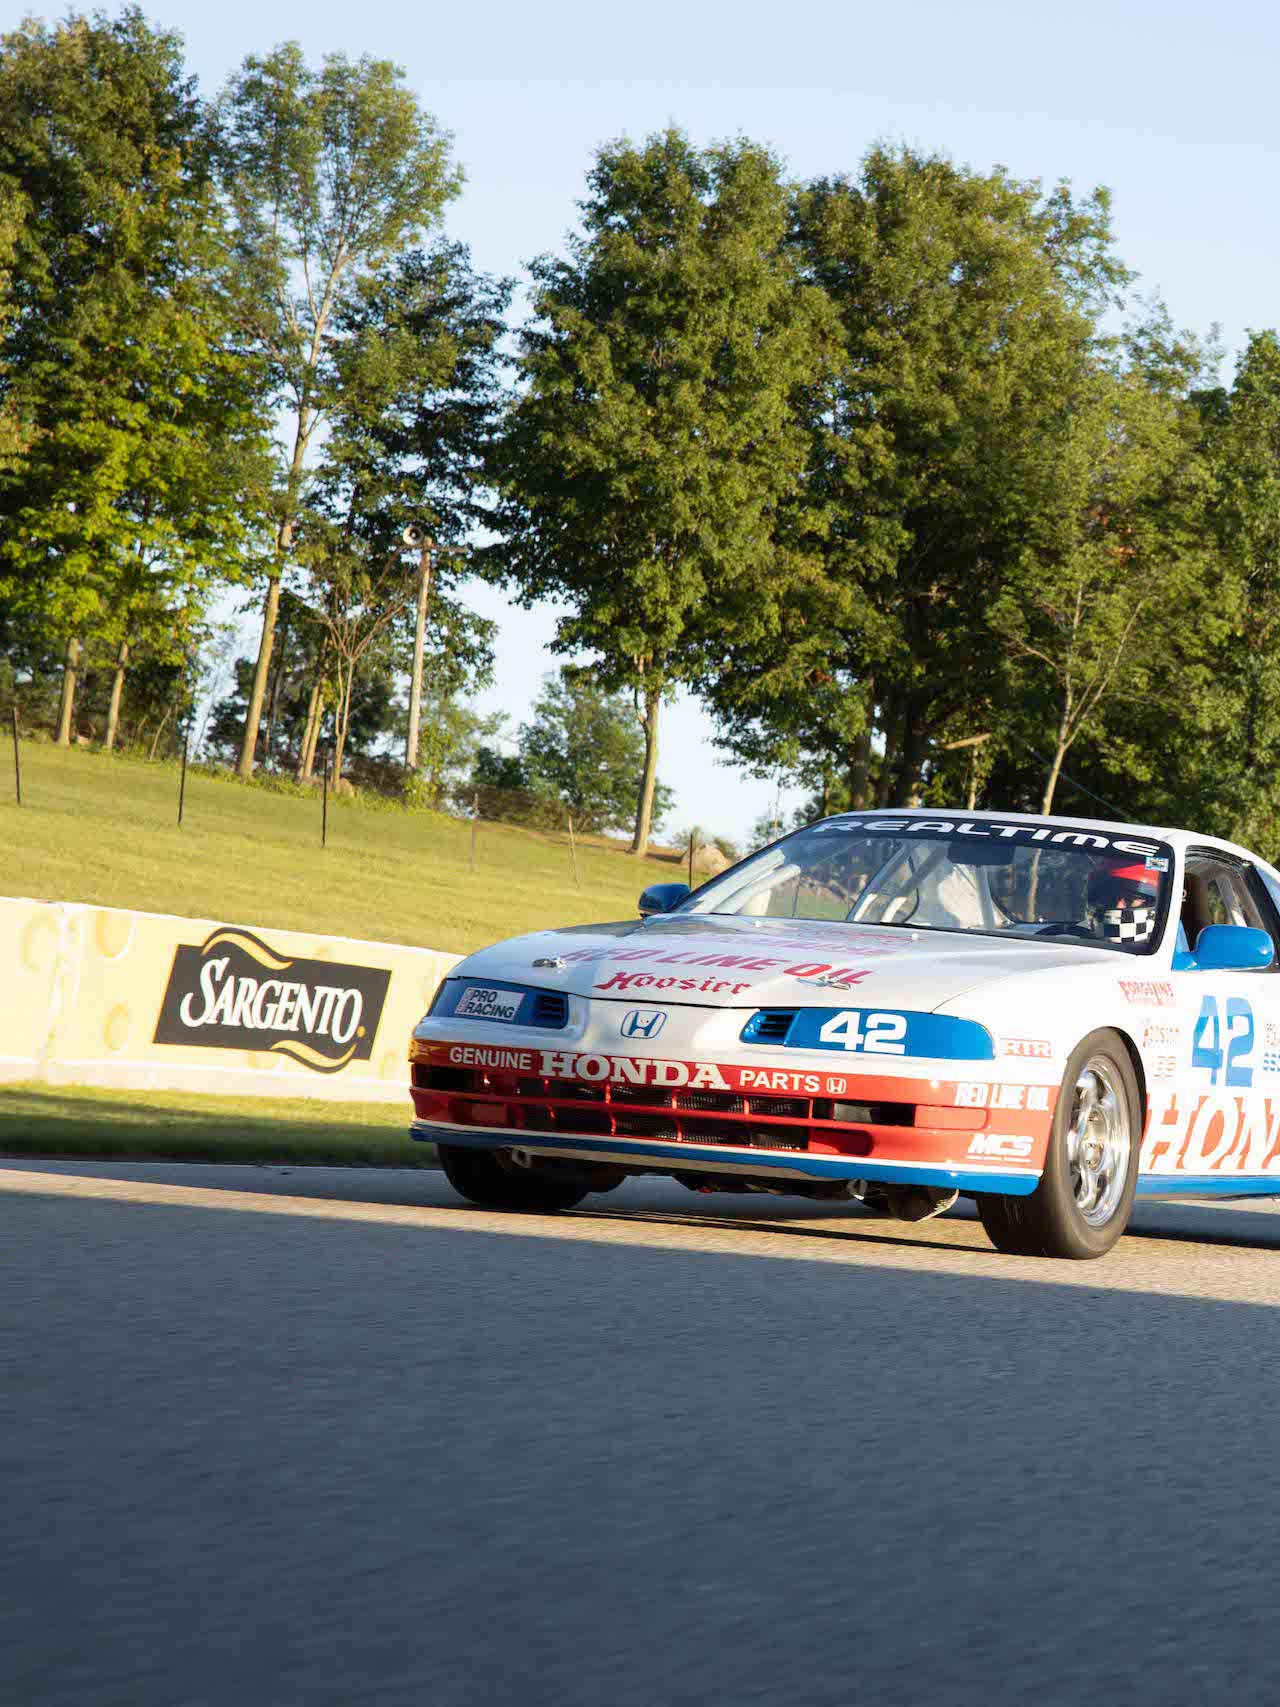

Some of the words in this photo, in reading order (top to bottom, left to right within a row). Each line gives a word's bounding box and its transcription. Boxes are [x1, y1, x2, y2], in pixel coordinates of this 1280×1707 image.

[813, 820, 1160, 857] REALTIME
[652, 951, 792, 970] LINE
[783, 963, 875, 985] OIL
[470, 989, 498, 1003] PRO
[592, 971, 752, 995] Hoosier
[180, 957, 362, 1043] SARGENTO
[464, 1002, 515, 1019] RACING
[819, 1010, 907, 1055] 42
[1192, 994, 1255, 1088] 42
[1003, 1040, 1051, 1057] RTR
[449, 1046, 532, 1070] GENUINE
[539, 1050, 731, 1090] HONDA
[739, 1069, 820, 1093] PARTS
[954, 1083, 989, 1107] RED
[967, 1133, 1034, 1157] MCS
